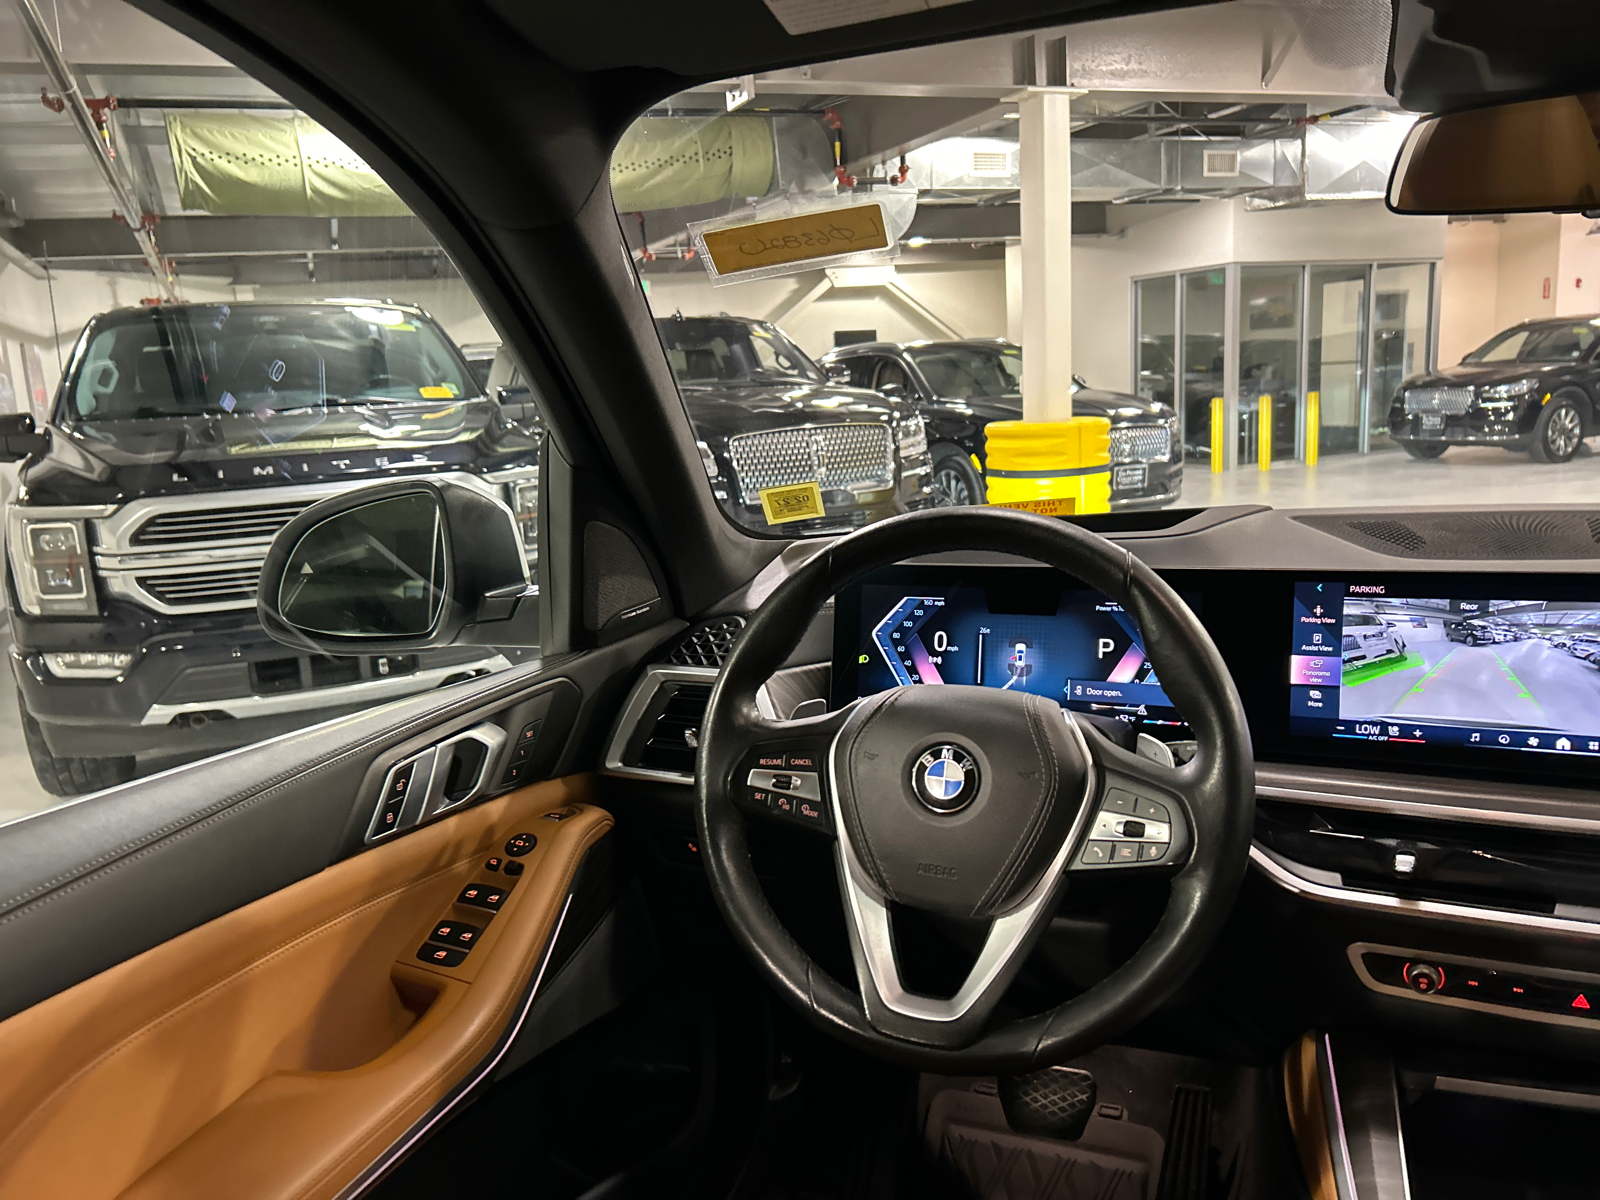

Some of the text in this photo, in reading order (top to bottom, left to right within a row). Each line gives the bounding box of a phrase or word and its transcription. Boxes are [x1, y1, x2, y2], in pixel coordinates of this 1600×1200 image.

[172, 453, 428, 482] LIMITED
[1349, 585, 1385, 594] PARKING
[1460, 602, 1479, 610] Rear
[933, 631, 948, 652] 0
[1098, 638, 1115, 659] P
[1086, 688, 1122, 697] Door open.
[1355, 724, 1380, 735] LOW
[759, 758, 783, 766] RESUME
[790, 758, 813, 766] CANCEL
[921, 748, 974, 772] BMW
[754, 792, 766, 800] SET
[802, 810, 819, 818] MODE
[917, 862, 958, 880] AIRBAG
